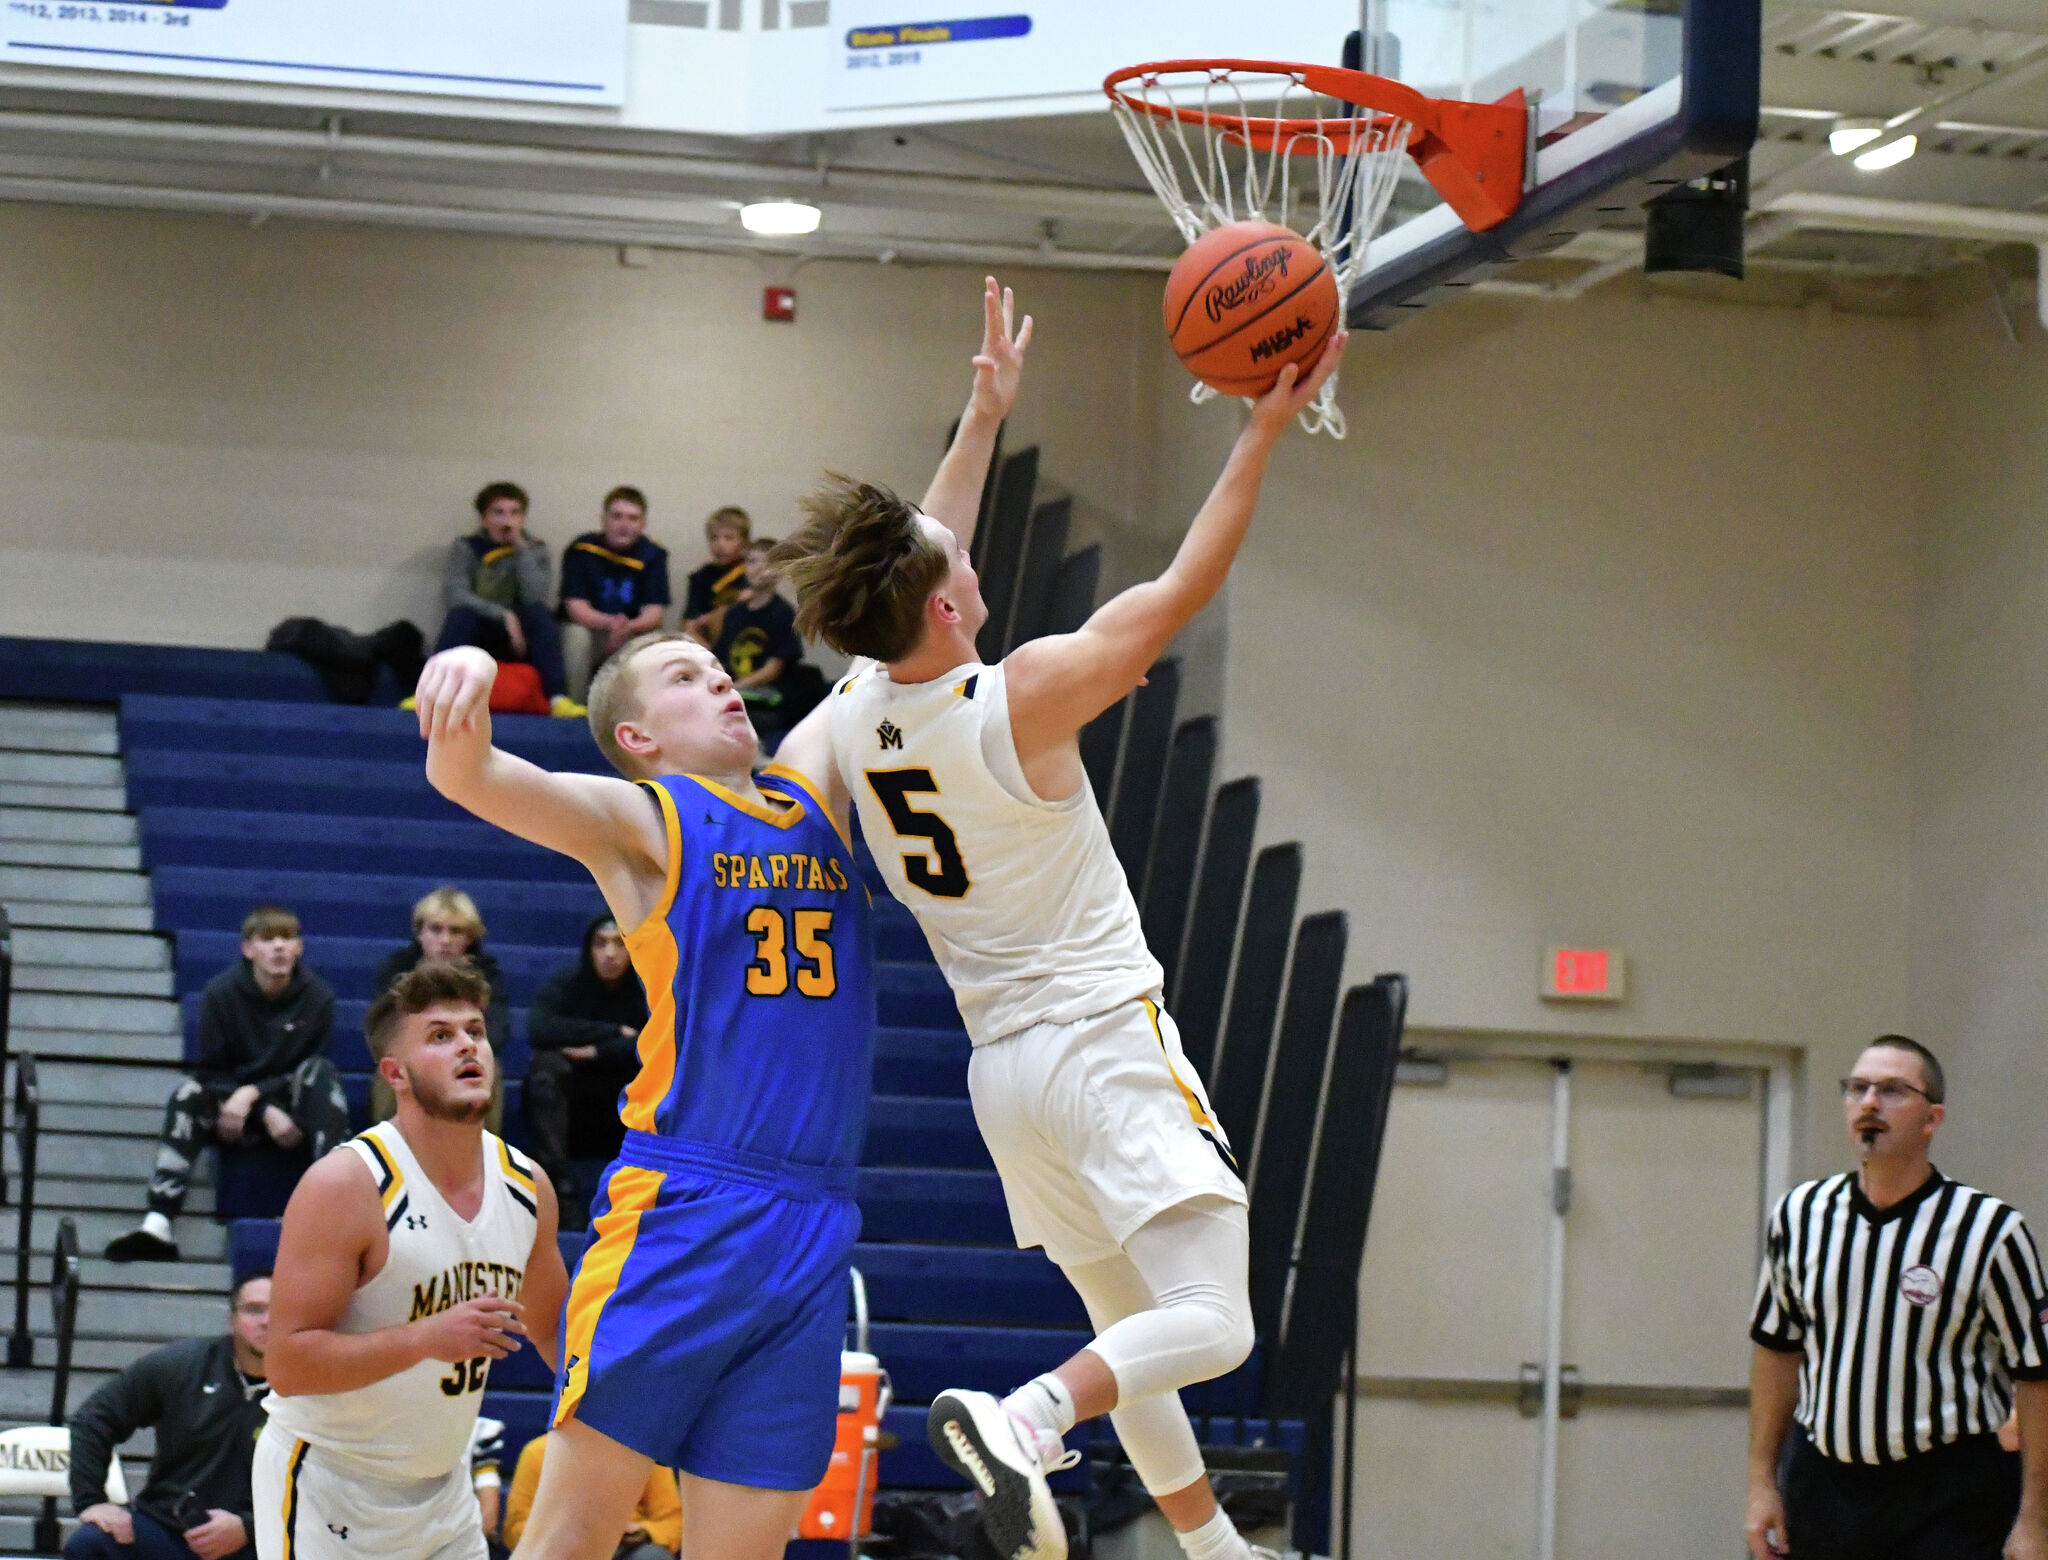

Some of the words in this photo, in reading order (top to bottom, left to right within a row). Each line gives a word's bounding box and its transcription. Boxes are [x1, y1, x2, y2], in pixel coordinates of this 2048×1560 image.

[108, 9, 147, 23] 2014
[1206, 246, 1293, 323] Rawlings
[863, 765, 973, 900] 5
[745, 905, 838, 1000] 35
